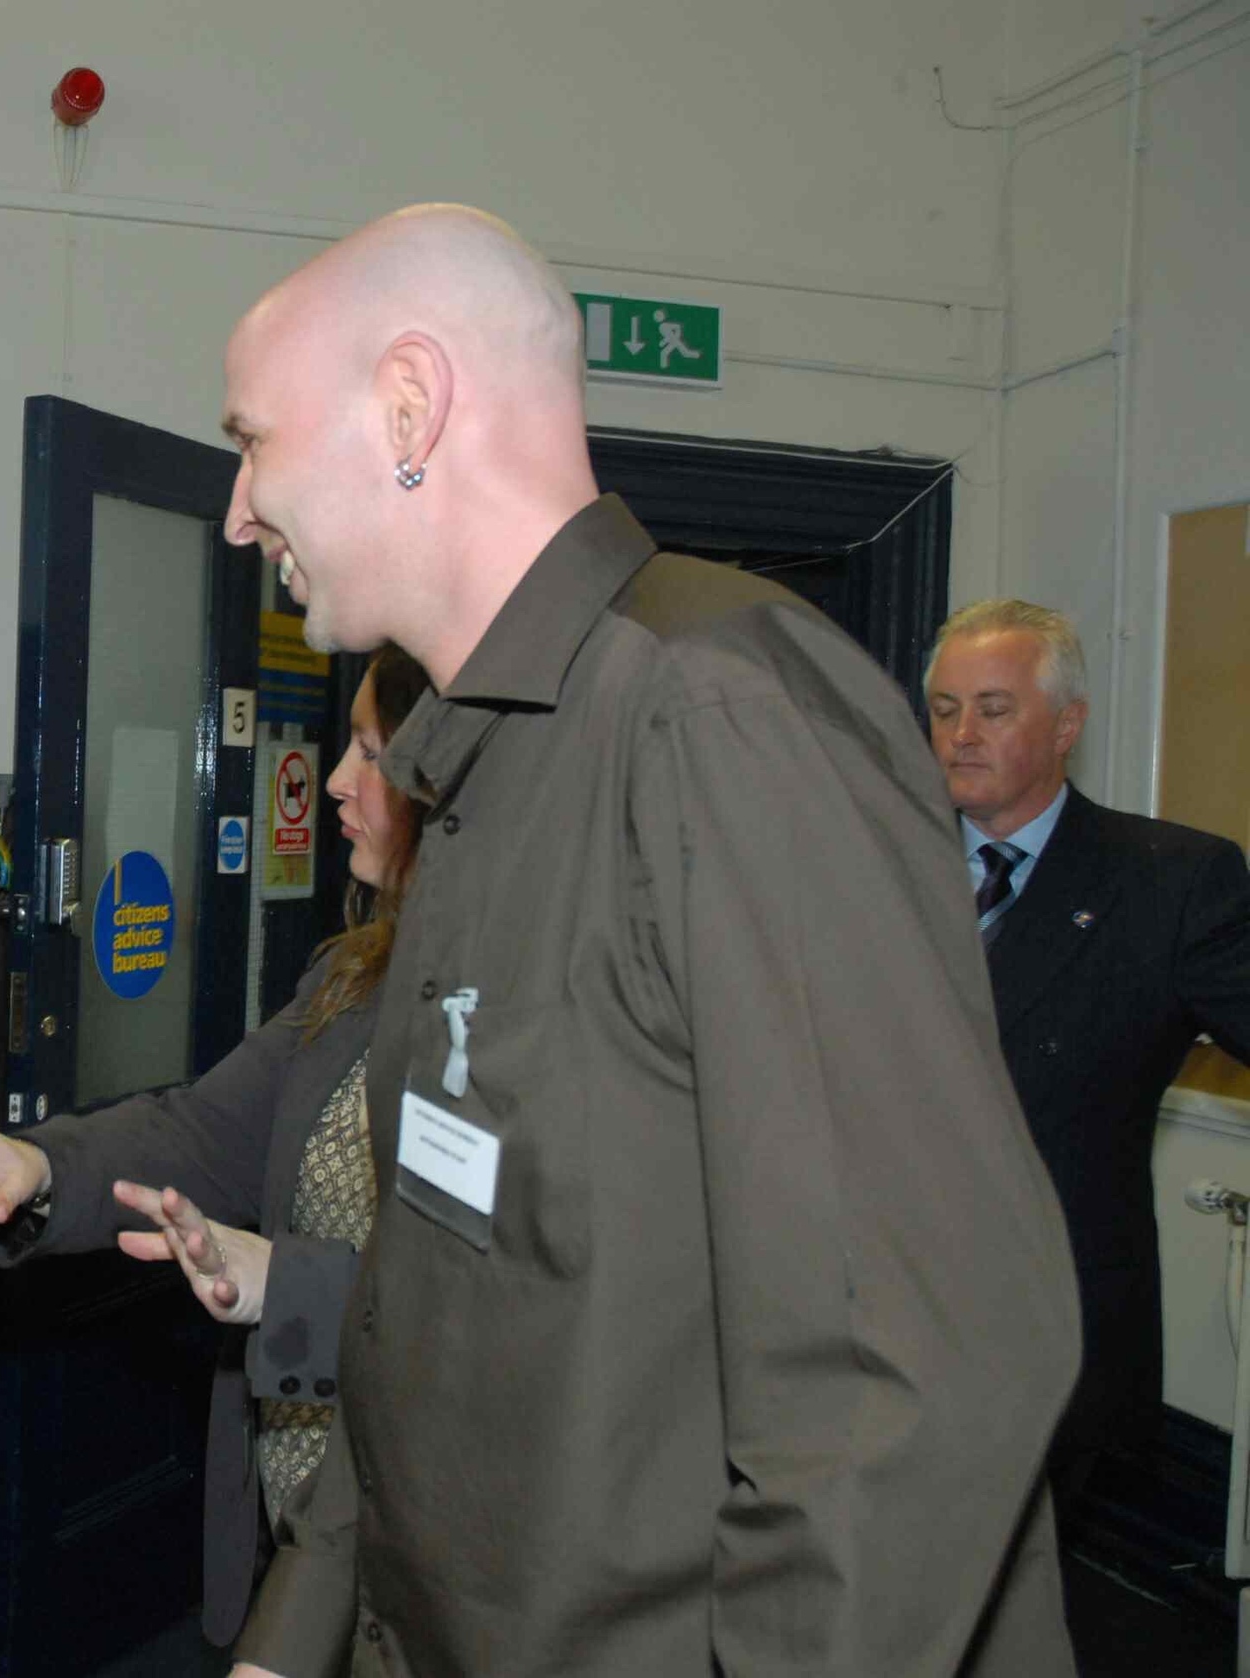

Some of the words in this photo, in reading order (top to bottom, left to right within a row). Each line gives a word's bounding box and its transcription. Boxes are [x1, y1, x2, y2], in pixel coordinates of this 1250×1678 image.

[232, 701, 245, 734] 5
[113, 901, 171, 926] citizens
[112, 925, 163, 950] advice
[113, 950, 168, 974] bureau
